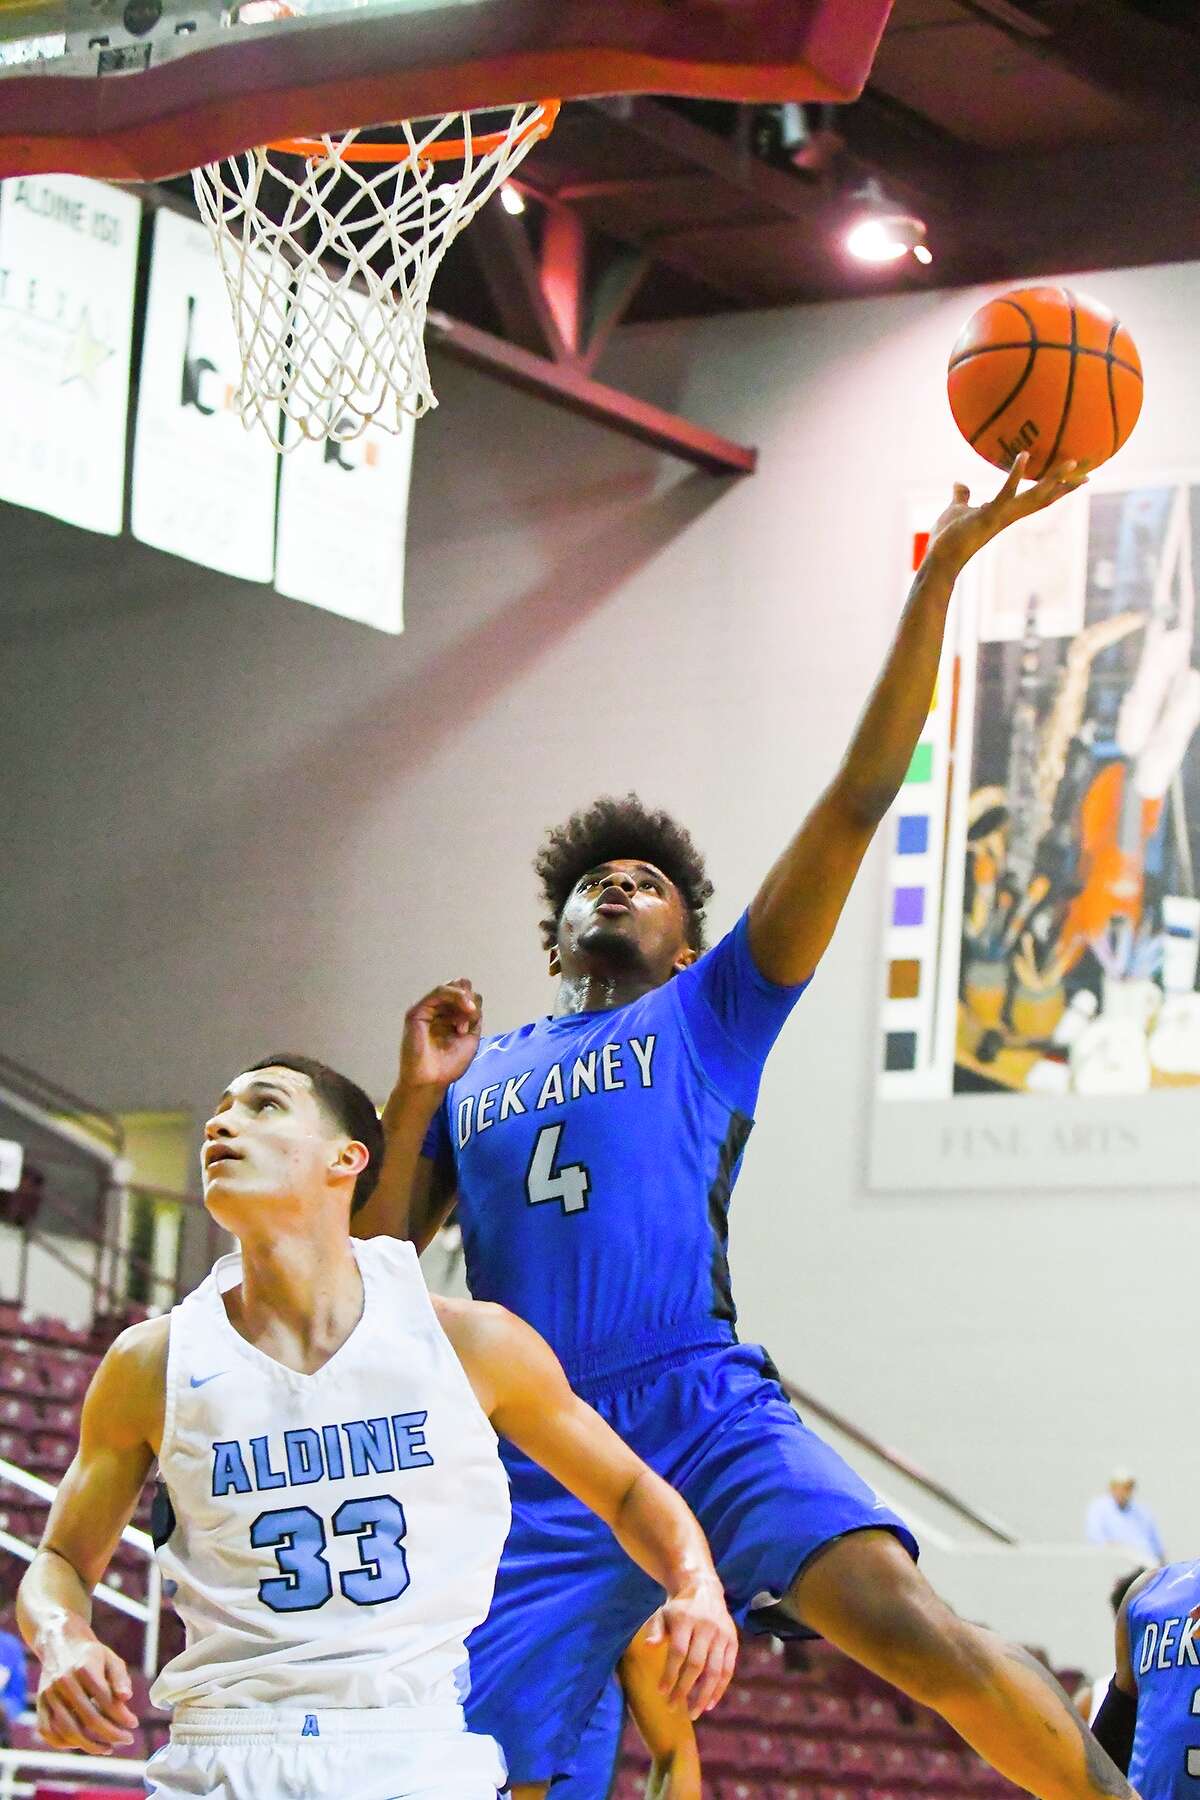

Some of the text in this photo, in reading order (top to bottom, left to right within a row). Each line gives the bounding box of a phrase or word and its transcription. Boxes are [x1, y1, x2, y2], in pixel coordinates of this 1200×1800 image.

[457, 1033, 657, 1151] DEKANEY
[526, 1120, 592, 1217] 4
[212, 1410, 434, 1497] ALDINE
[250, 1494, 411, 1613] 33
[301, 1714, 320, 1737] A
